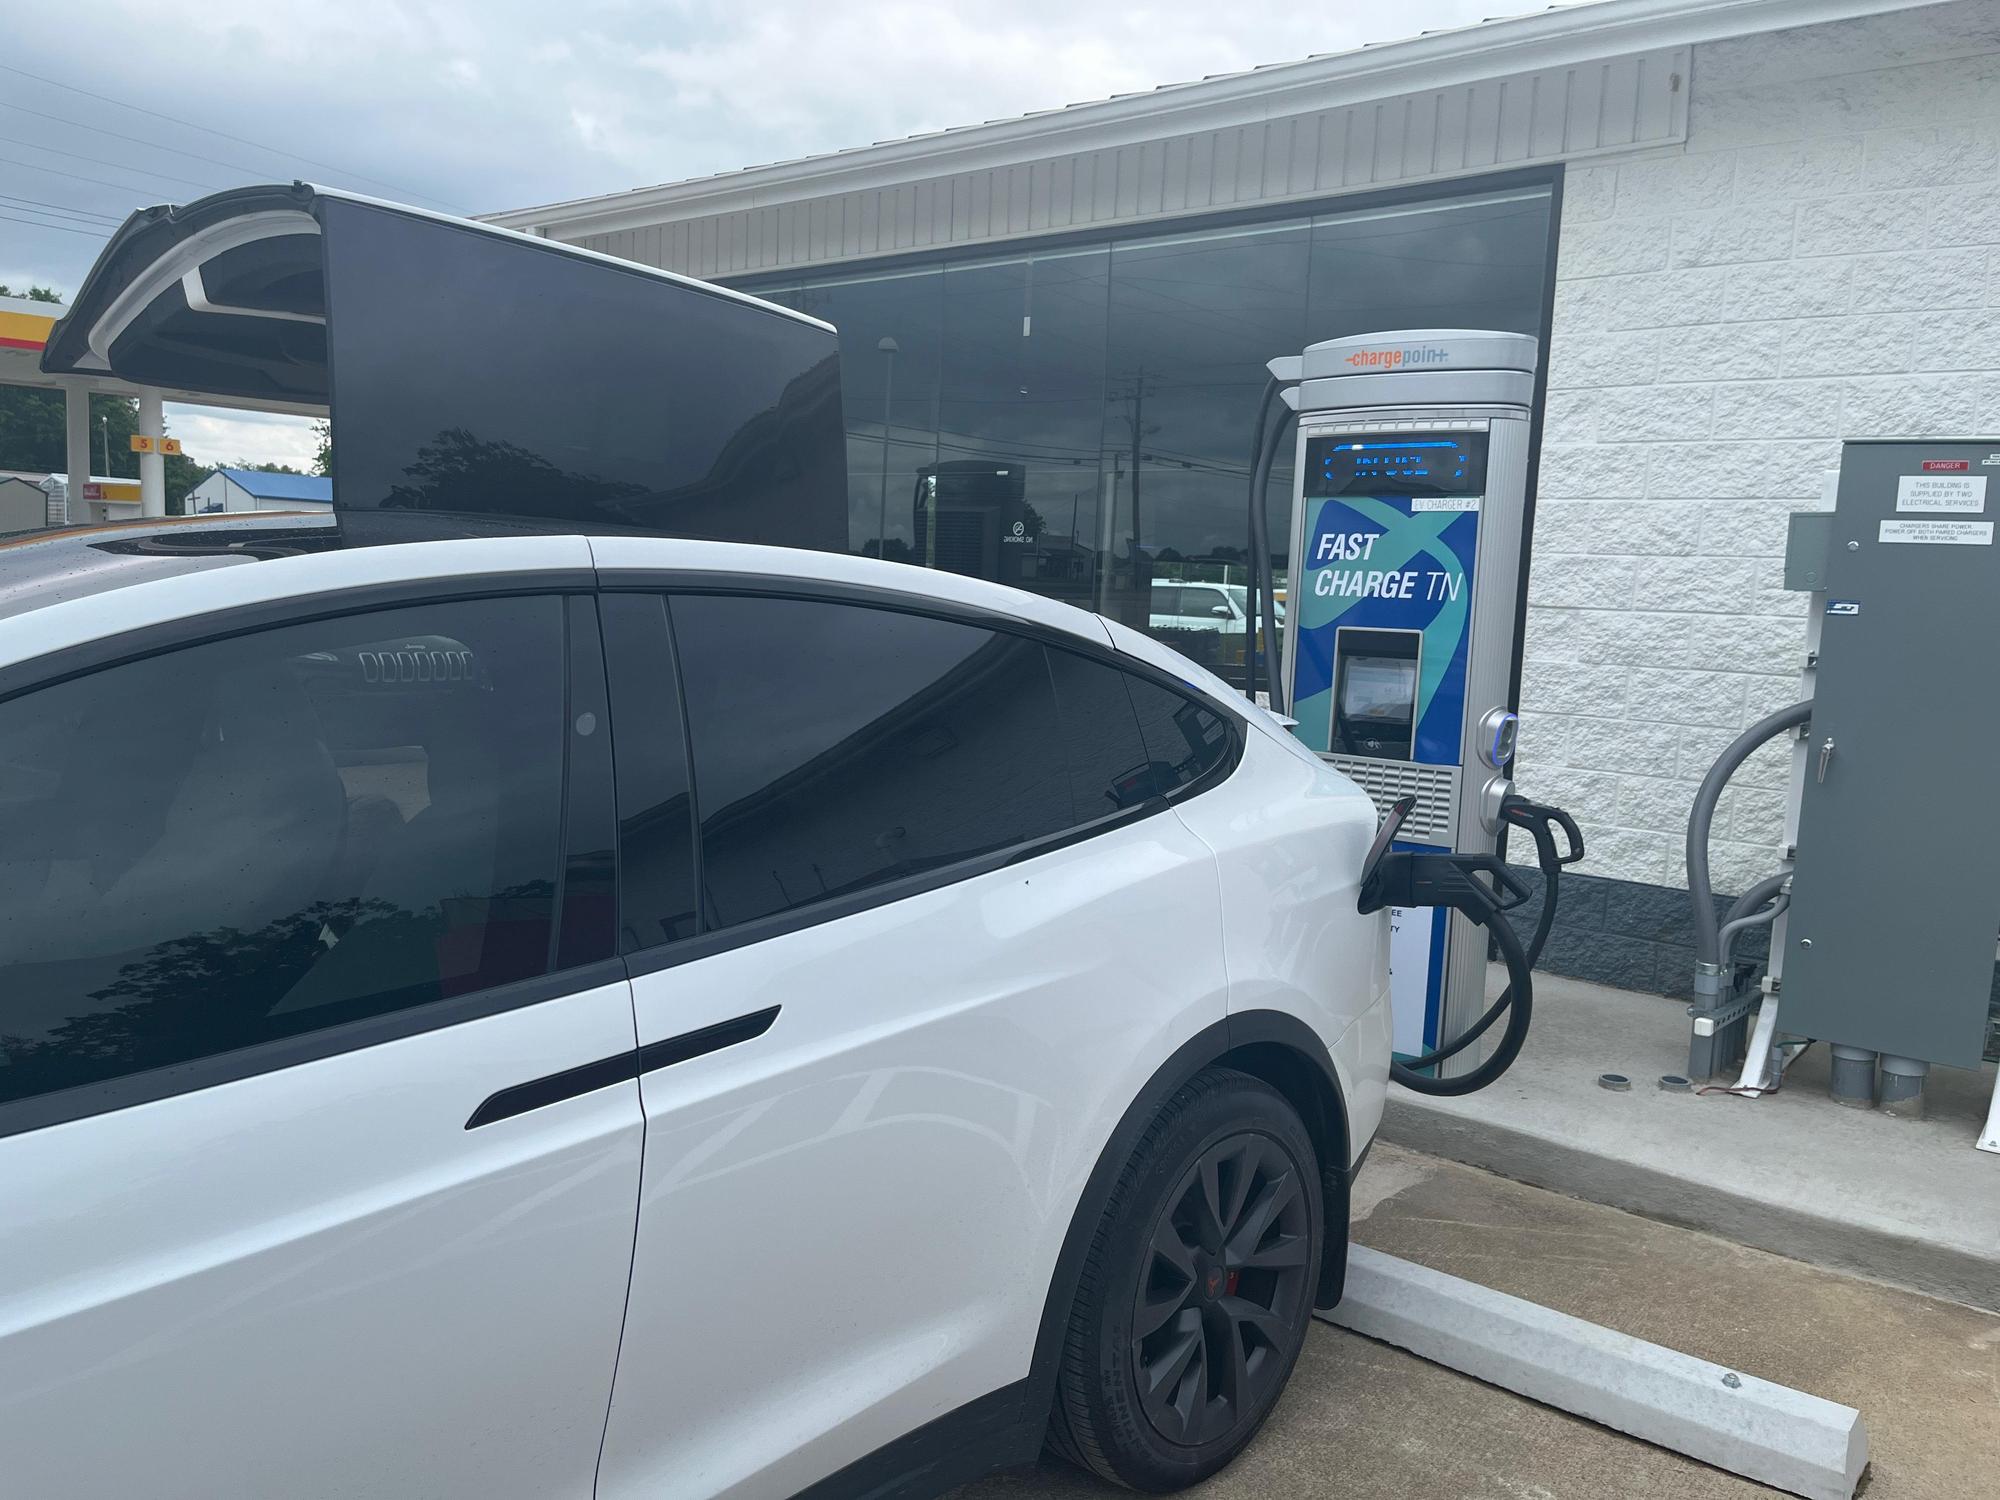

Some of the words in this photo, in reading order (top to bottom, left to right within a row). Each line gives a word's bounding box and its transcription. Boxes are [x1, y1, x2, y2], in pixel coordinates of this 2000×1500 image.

[140, 438, 148, 448] 5
[166, 441, 174, 451] 6
[1915, 481, 1930, 489] THIS
[1932, 481, 1962, 489] BUILDING
[1956, 490, 1973, 498] TWO
[1427, 499, 1463, 510] CHARGER
[1465, 499, 1476, 510] #2
[1945, 499, 1979, 507] SERVICES
[1316, 533, 1380, 561] FAST
[1314, 569, 1419, 599] CHARGE
[1426, 571, 1463, 601] TN
